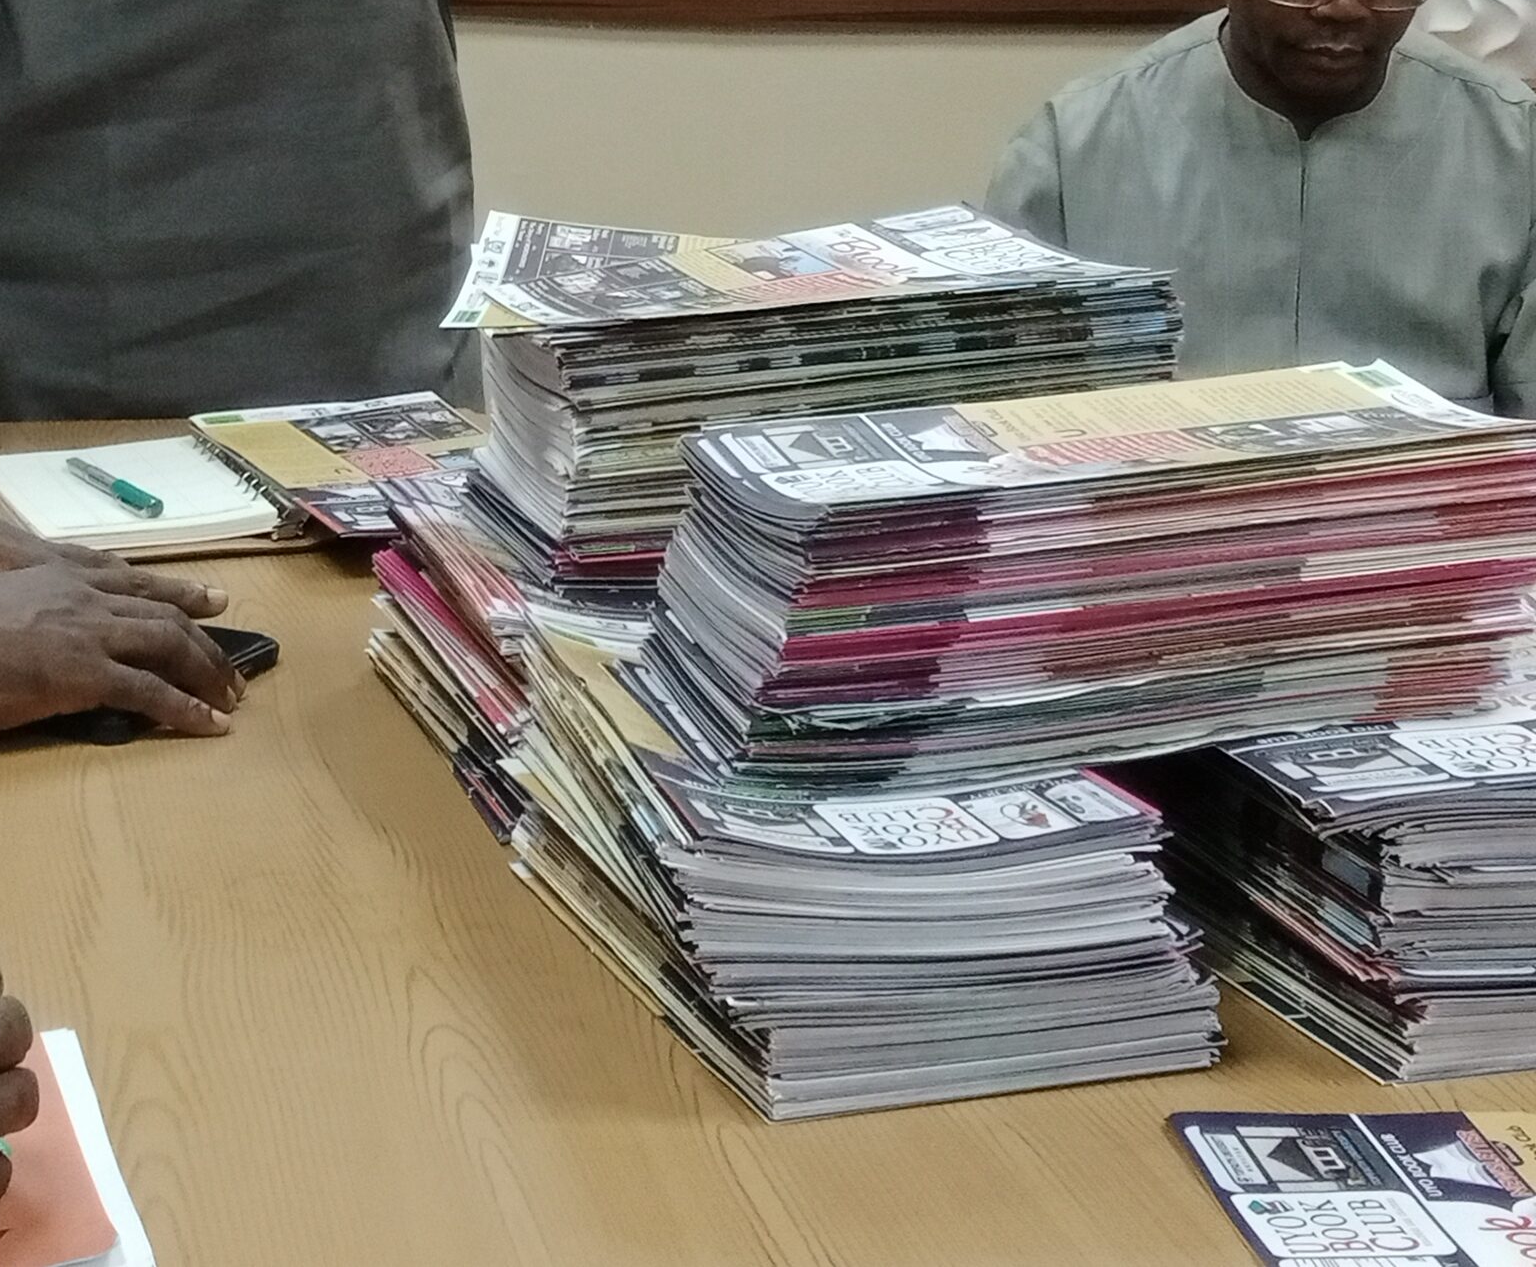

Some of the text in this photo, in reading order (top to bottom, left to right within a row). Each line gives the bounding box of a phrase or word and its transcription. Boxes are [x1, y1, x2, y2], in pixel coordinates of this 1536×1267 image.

[1416, 730, 1533, 750] CLUB
[837, 804, 954, 826] CLUB
[850, 817, 964, 841] BOOK
[897, 828, 988, 848] UYO
[1379, 1133, 1409, 1154] CLUB
[1400, 1154, 1431, 1179] BOOK
[1417, 1178, 1444, 1197] UYO
[1264, 1215, 1331, 1255] UYO
[1297, 1198, 1377, 1254] BOOK
[1346, 1198, 1422, 1252] CLUB
